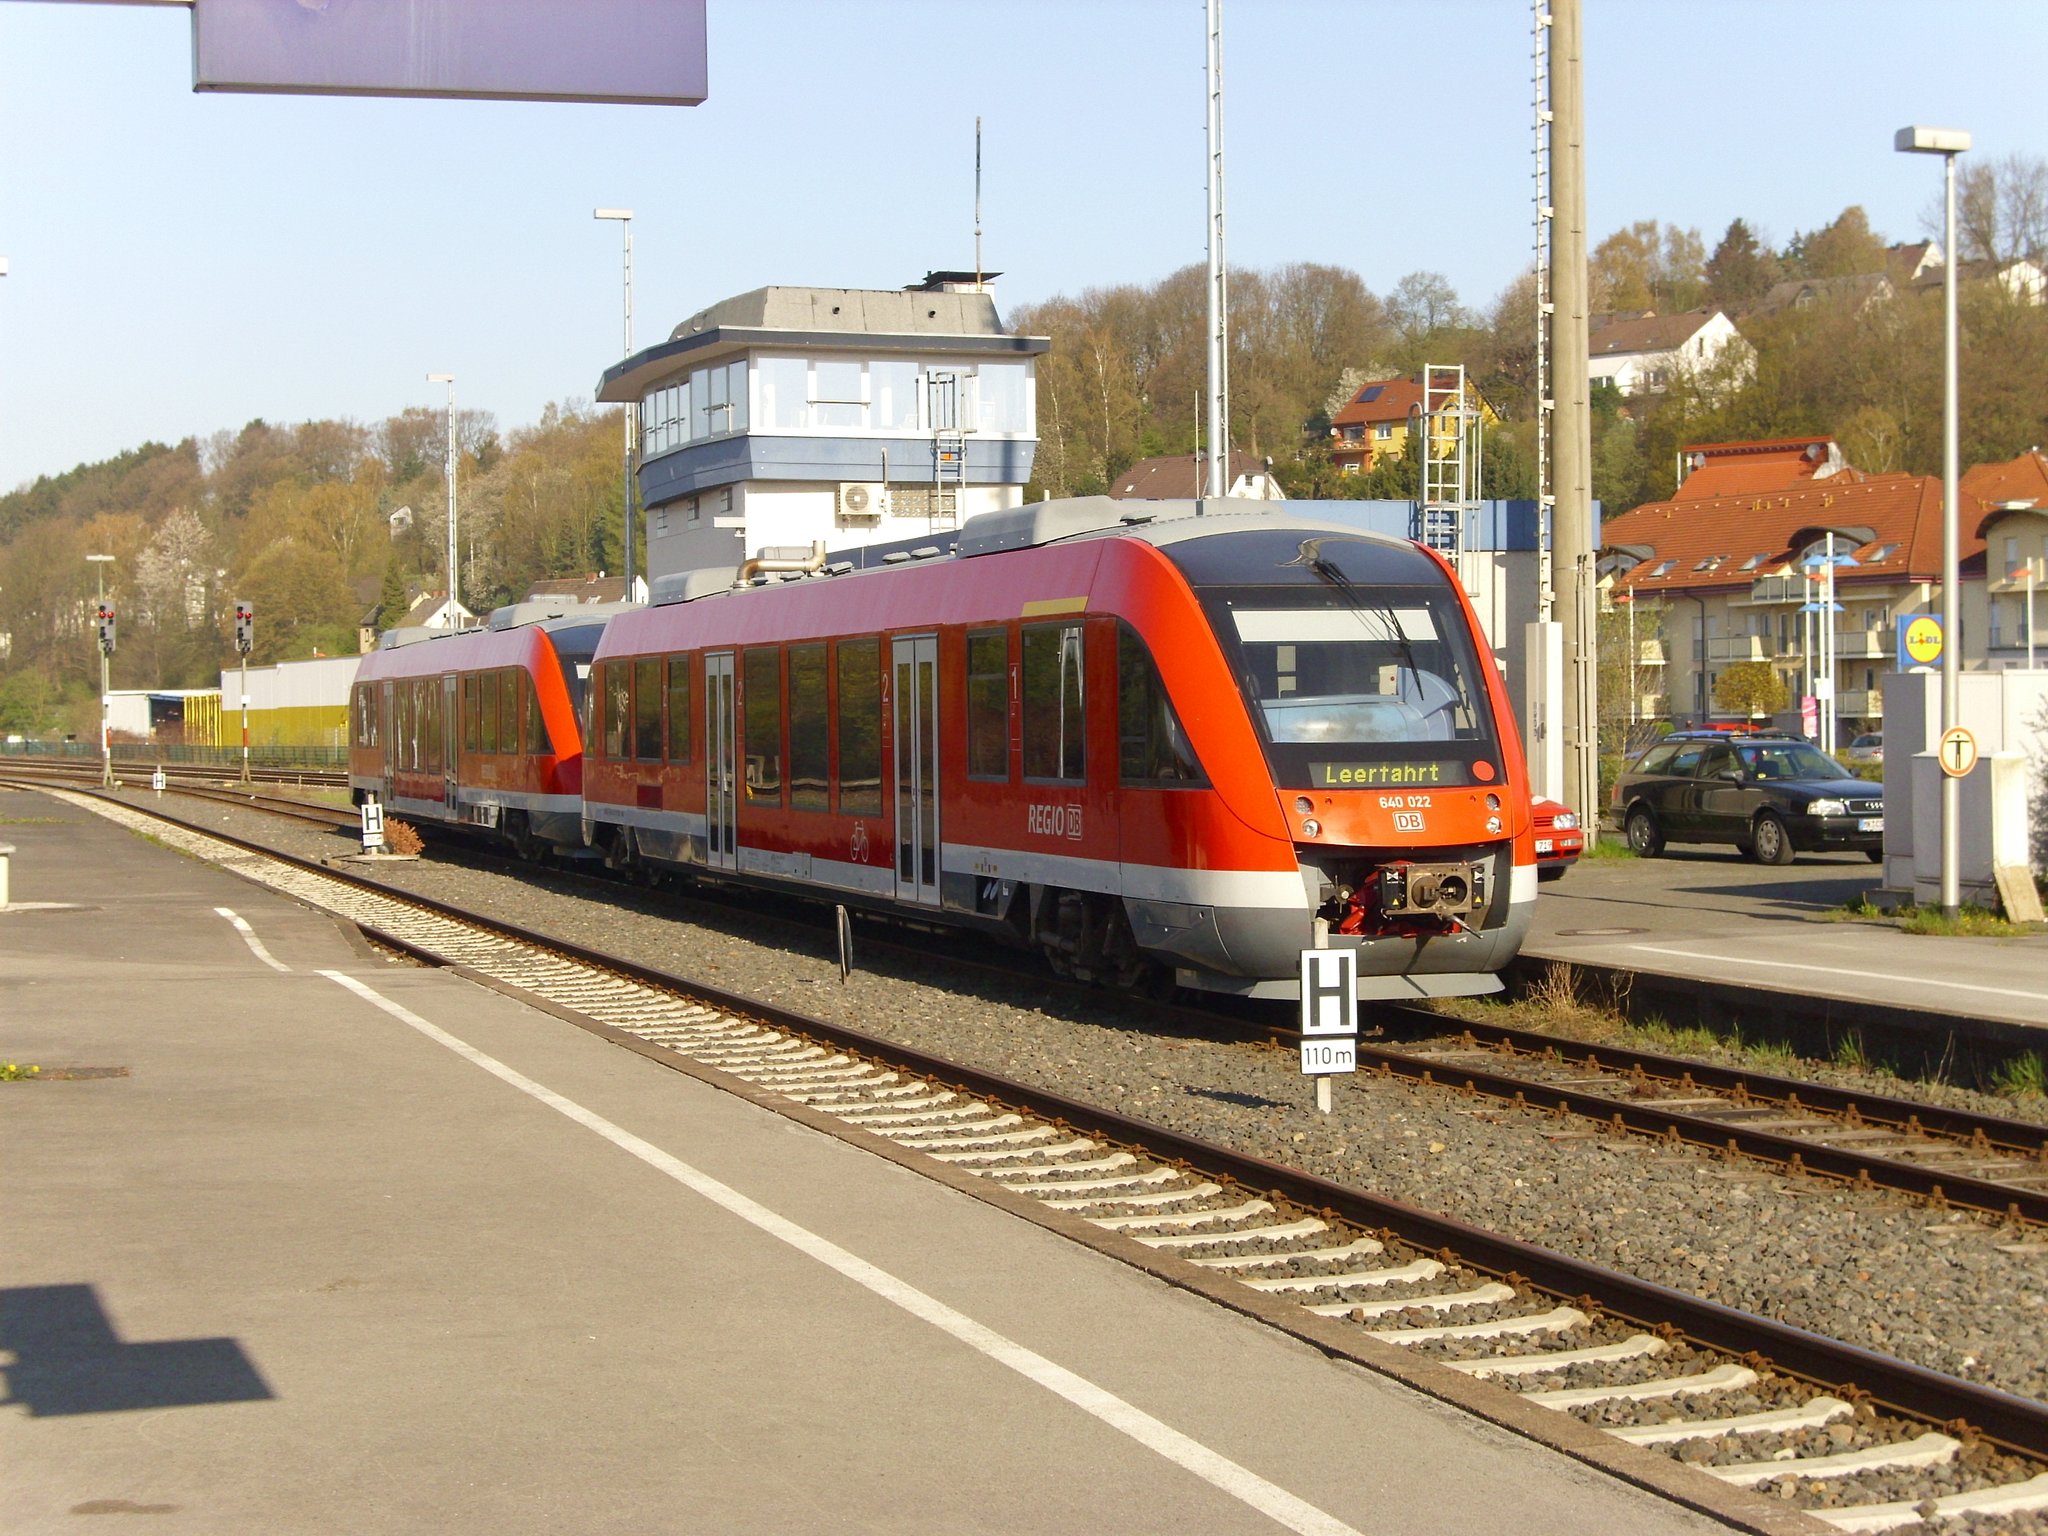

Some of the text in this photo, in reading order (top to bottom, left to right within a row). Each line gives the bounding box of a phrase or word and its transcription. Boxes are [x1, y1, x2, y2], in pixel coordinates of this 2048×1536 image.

[882, 673, 889, 703] 2
[155, 775, 164, 788] H
[1326, 763, 1439, 784] Leerfahrt
[1378, 795, 1432, 809] 640 022
[365, 807, 381, 831] H
[1028, 804, 1082, 836] REGIO DB
[1396, 813, 1423, 829] DB
[1309, 956, 1351, 1027] H
